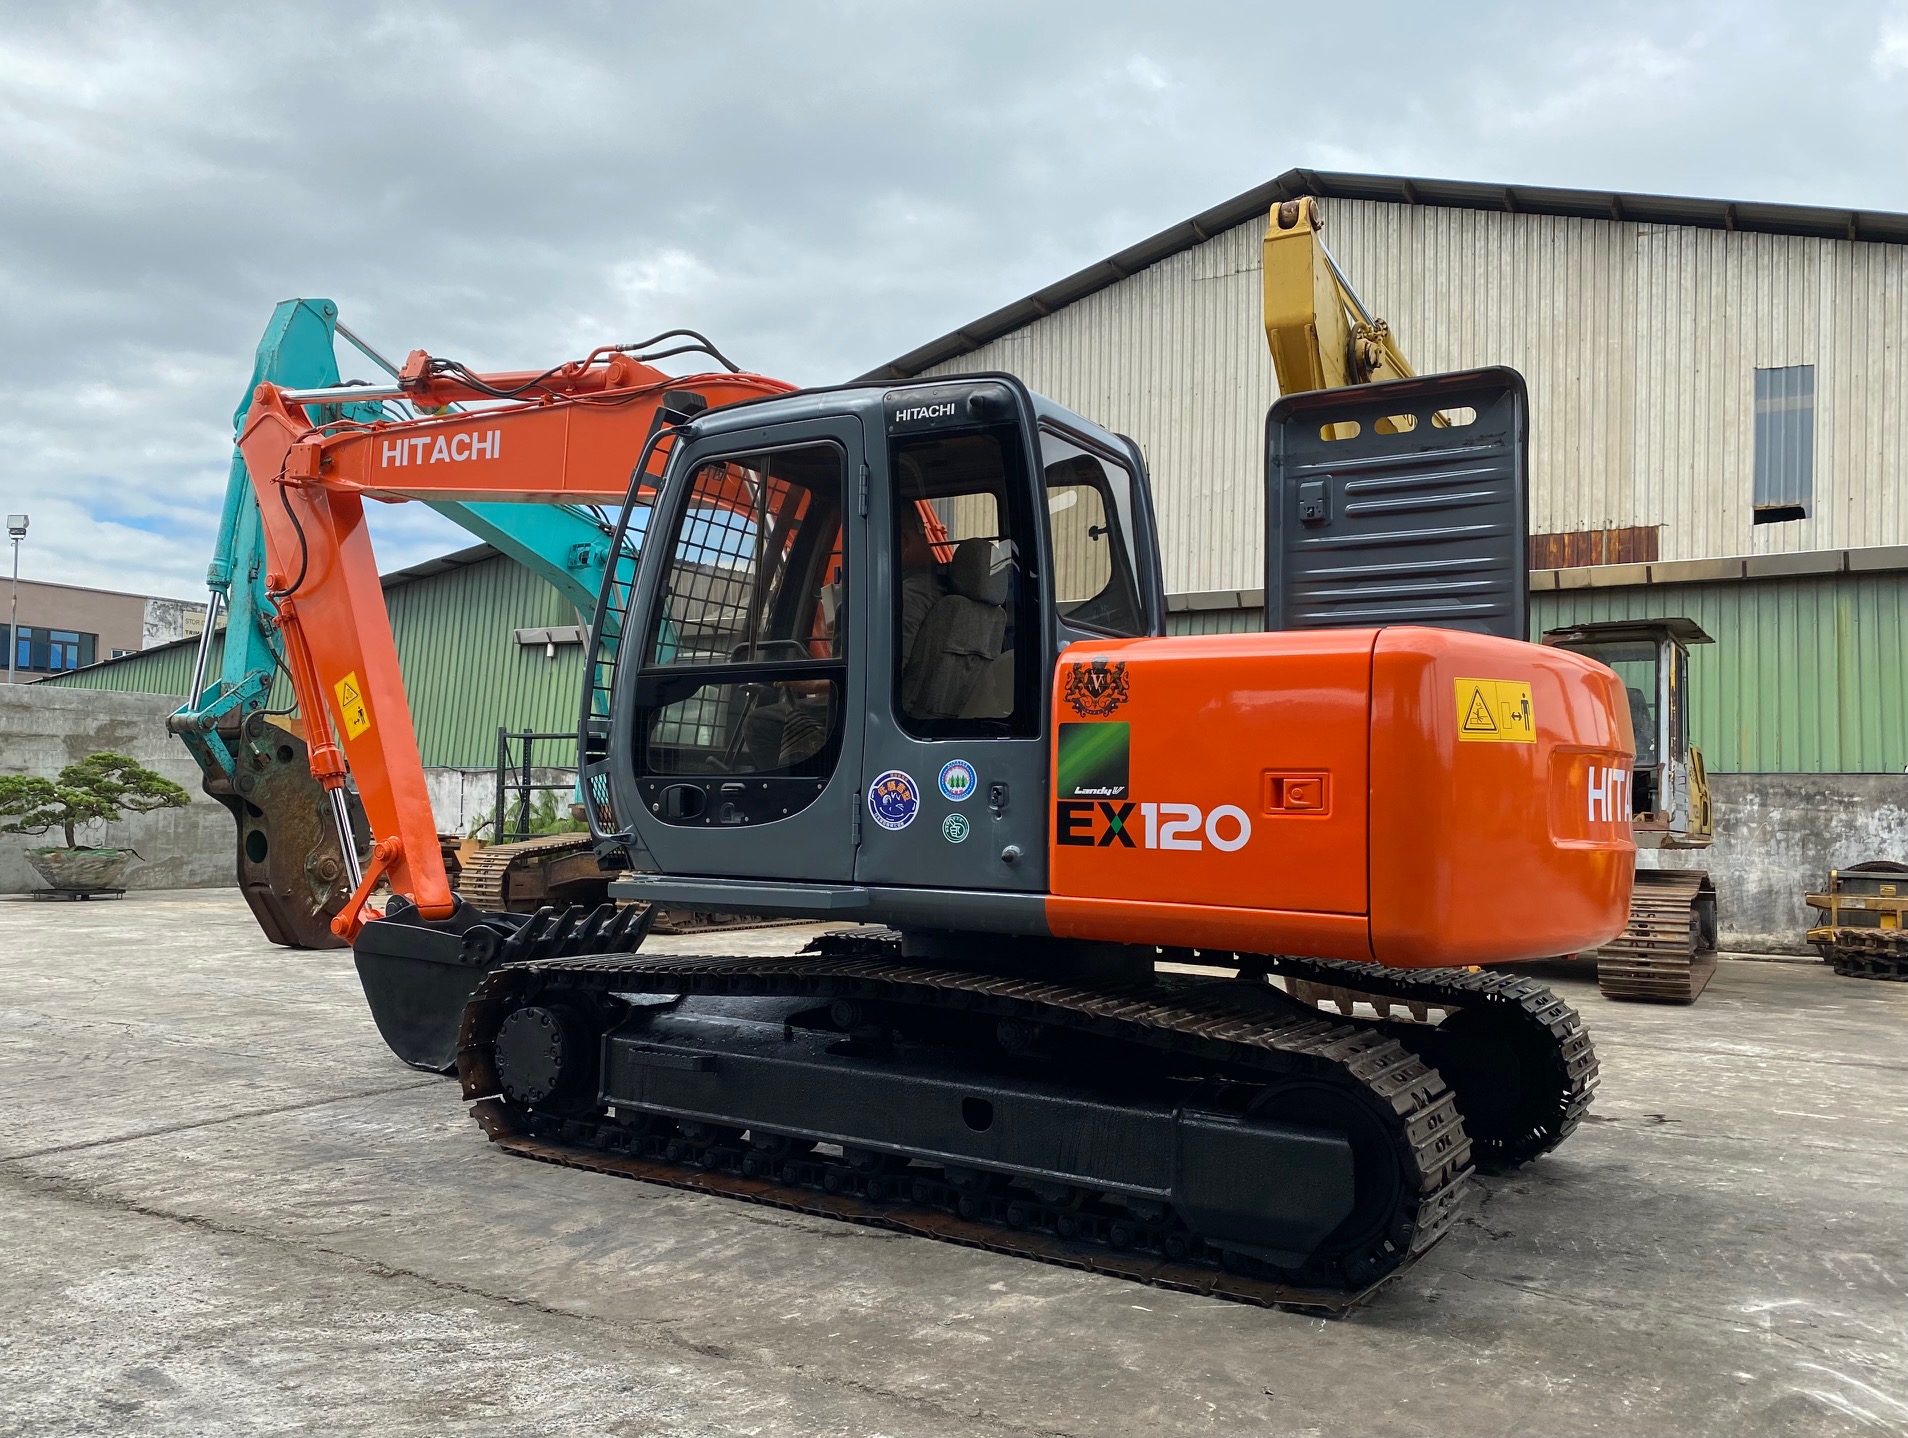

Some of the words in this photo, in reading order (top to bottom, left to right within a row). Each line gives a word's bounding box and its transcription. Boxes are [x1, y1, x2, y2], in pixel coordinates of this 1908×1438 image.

[896, 403, 955, 422] HITACHI
[381, 430, 501, 468] HITACHI
[1056, 800, 1252, 852] EX120
